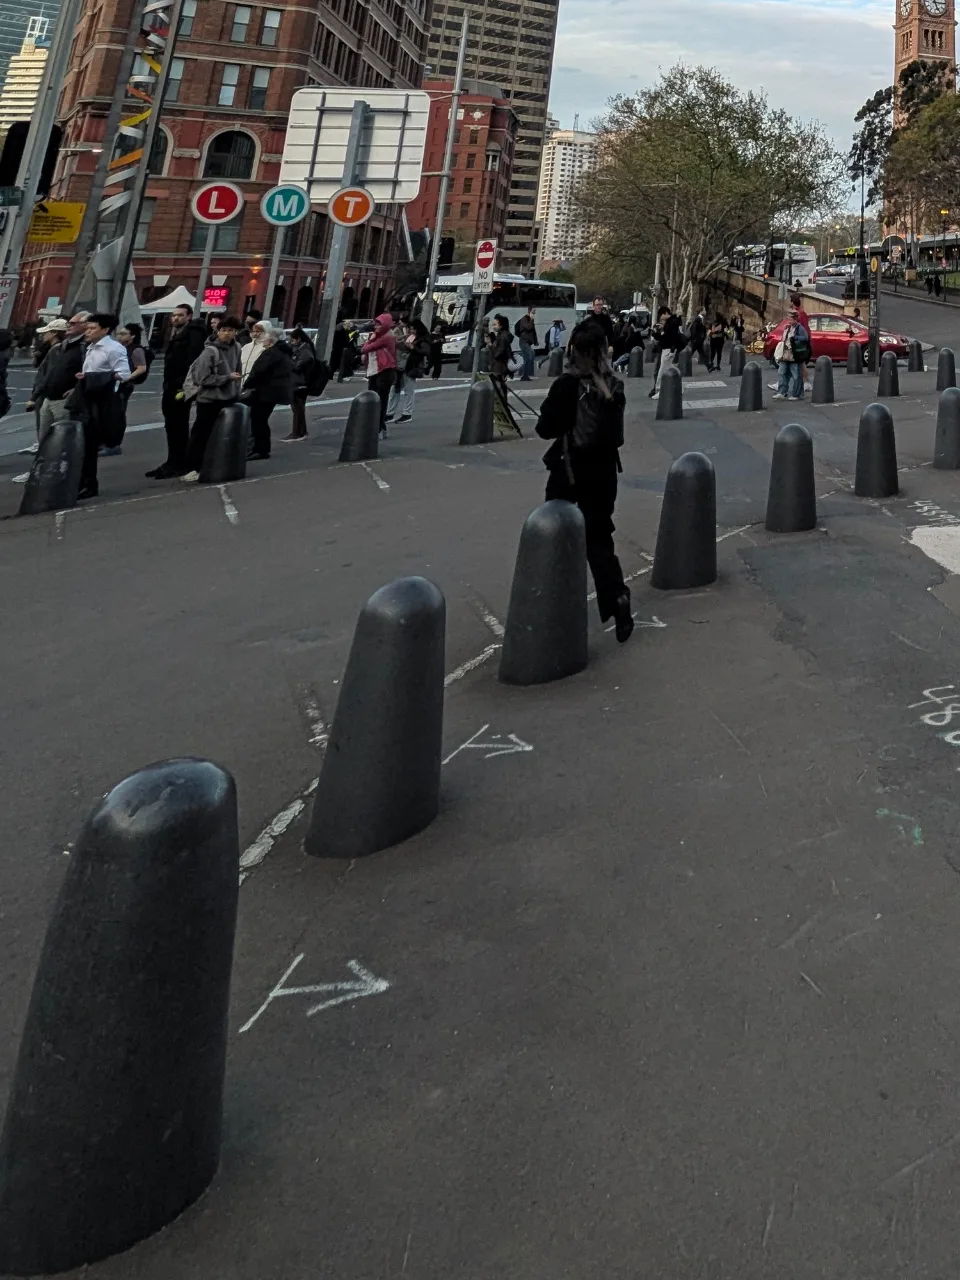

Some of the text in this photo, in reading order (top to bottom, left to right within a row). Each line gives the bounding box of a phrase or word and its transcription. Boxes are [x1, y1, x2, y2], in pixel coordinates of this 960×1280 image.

[208, 191, 225, 214] L
[272, 195, 299, 216] M
[343, 196, 362, 218] T
[477, 271, 488, 280] NO
[204, 289, 227, 297] SIDE
